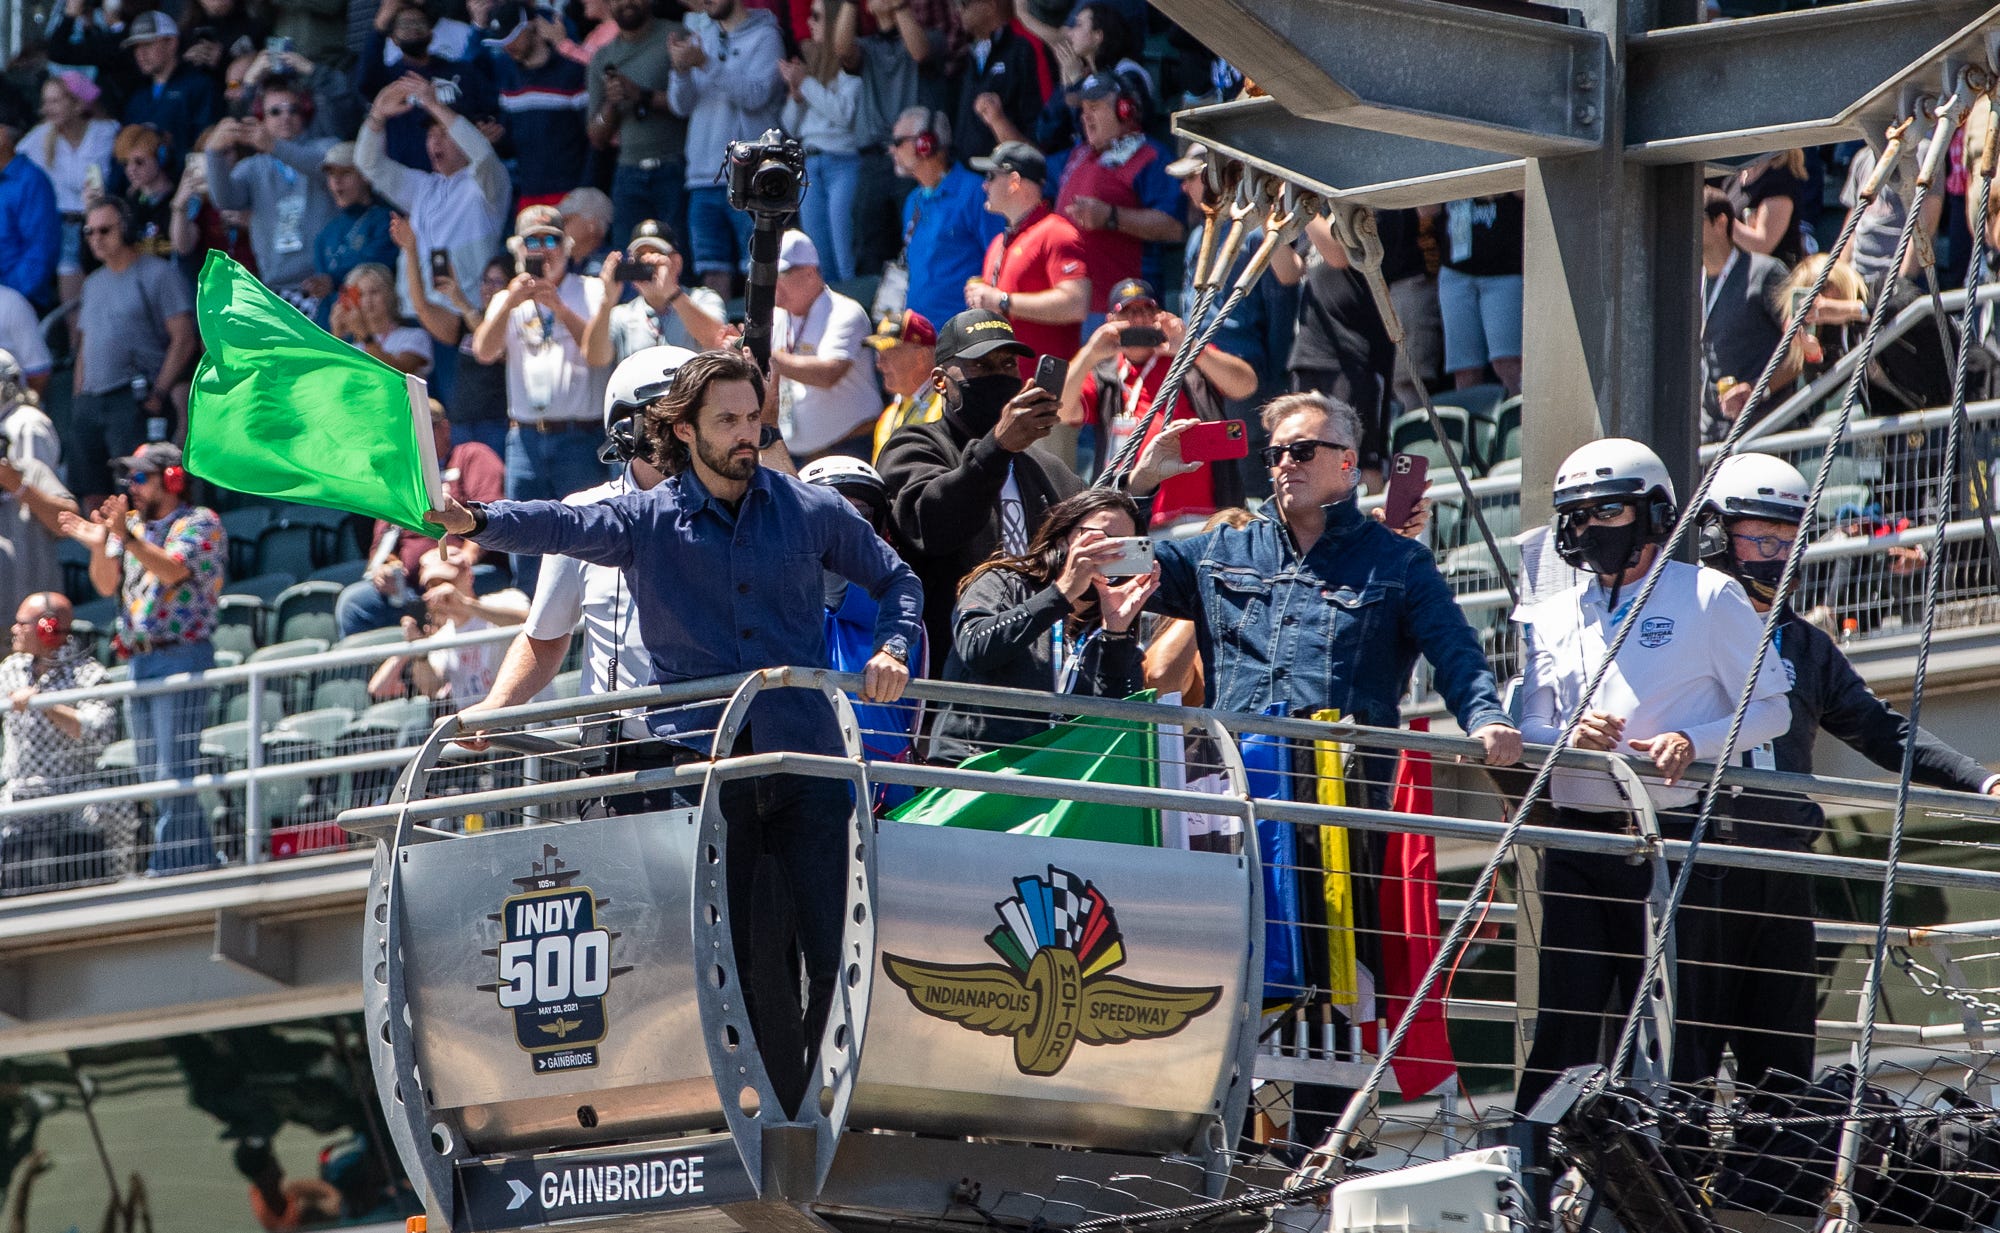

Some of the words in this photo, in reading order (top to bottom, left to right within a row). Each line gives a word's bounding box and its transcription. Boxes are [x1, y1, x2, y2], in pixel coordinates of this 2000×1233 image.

[537, 879, 556, 889] 105TH
[515, 897, 583, 937] INDY
[499, 930, 609, 1008] 500
[538, 1006, 551, 1016] MAY
[552, 1004, 563, 1015] 30,
[563, 1002, 579, 1013] 2021
[925, 985, 1030, 1013] INDIANAPOLIS
[1047, 963, 1077, 1058] MOTOR
[1089, 1001, 1171, 1026] SPEEDWAY
[547, 1052, 593, 1069] GAINBRIDGE
[540, 1156, 705, 1209] GAINBRIDGE
